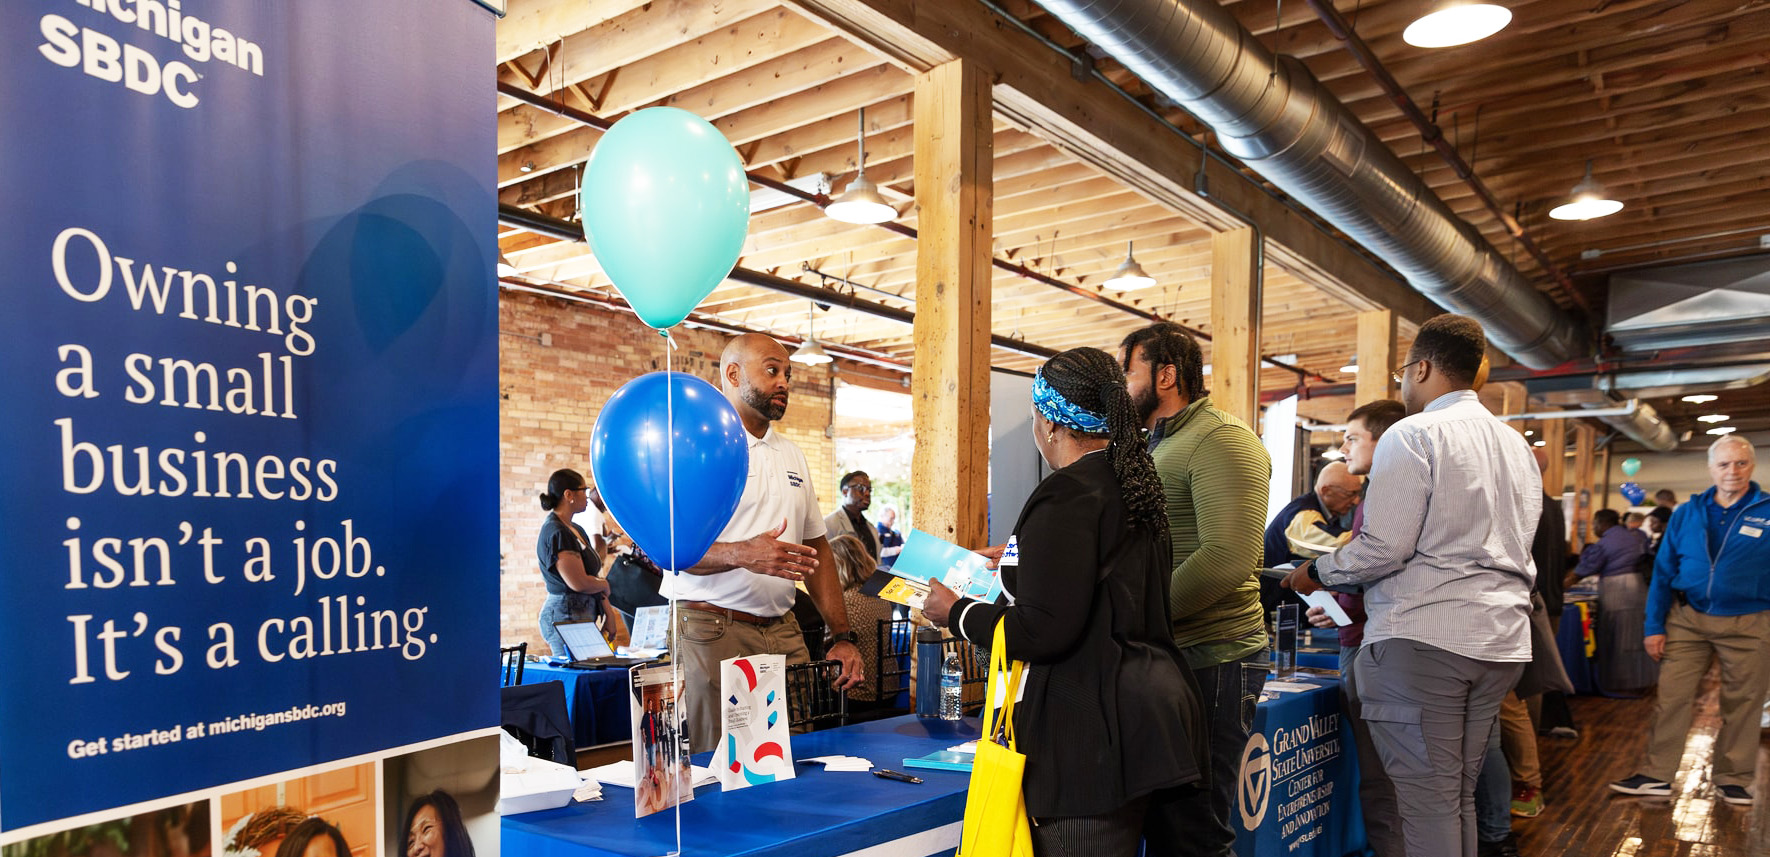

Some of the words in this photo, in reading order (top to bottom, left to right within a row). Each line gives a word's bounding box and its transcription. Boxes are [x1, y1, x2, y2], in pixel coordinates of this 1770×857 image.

[37, 13, 200, 109] SBDC
[75, 0, 264, 77] chigan
[51, 227, 318, 356] Owning
[55, 343, 100, 399] a
[124, 352, 298, 419] small
[54, 417, 338, 502] business
[63, 516, 225, 589] isn’t
[243, 537, 276, 583] a
[293, 519, 386, 596] job.
[66, 611, 184, 685] It’s
[206, 622, 239, 669] a
[258, 595, 438, 663] calling.
[67, 737, 108, 759] Get
[112, 725, 182, 752] started
[185, 722, 205, 740] at
[208, 702, 346, 736] michigansbdc.org
[1273, 723, 1310, 756] GRAND
[1308, 713, 1340, 740] VALLEY
[1272, 757, 1297, 781] STATE
[1288, 774, 1312, 798] CENTER
[1312, 769, 1324, 785] FOR
[1281, 820, 1295, 840] AND
